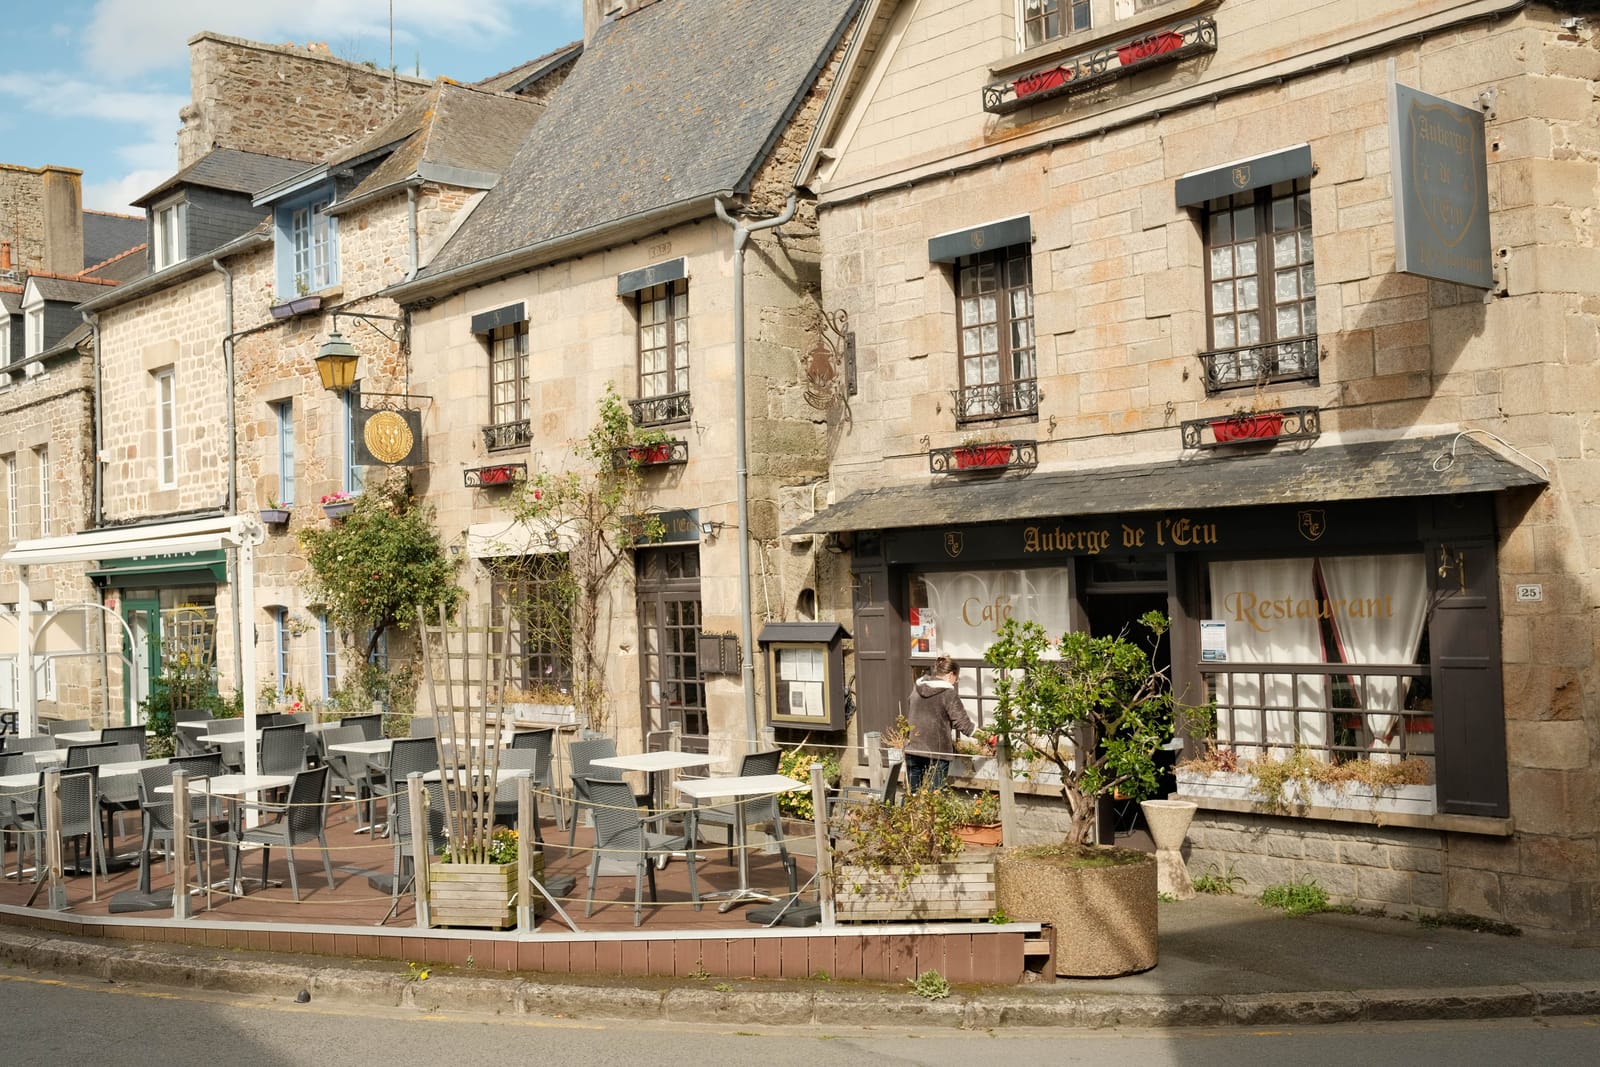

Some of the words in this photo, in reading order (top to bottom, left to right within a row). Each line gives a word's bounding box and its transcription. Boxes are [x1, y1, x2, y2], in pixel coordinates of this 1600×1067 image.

[1419, 115, 1469, 154] Auberge
[1023, 526, 1111, 555] Auberge
[1121, 523, 1145, 548] de
[1156, 517, 1218, 546] l'Ecu
[1224, 591, 1394, 633] Restaurant
[1521, 588, 1537, 598] 25
[962, 594, 1014, 632] Café
